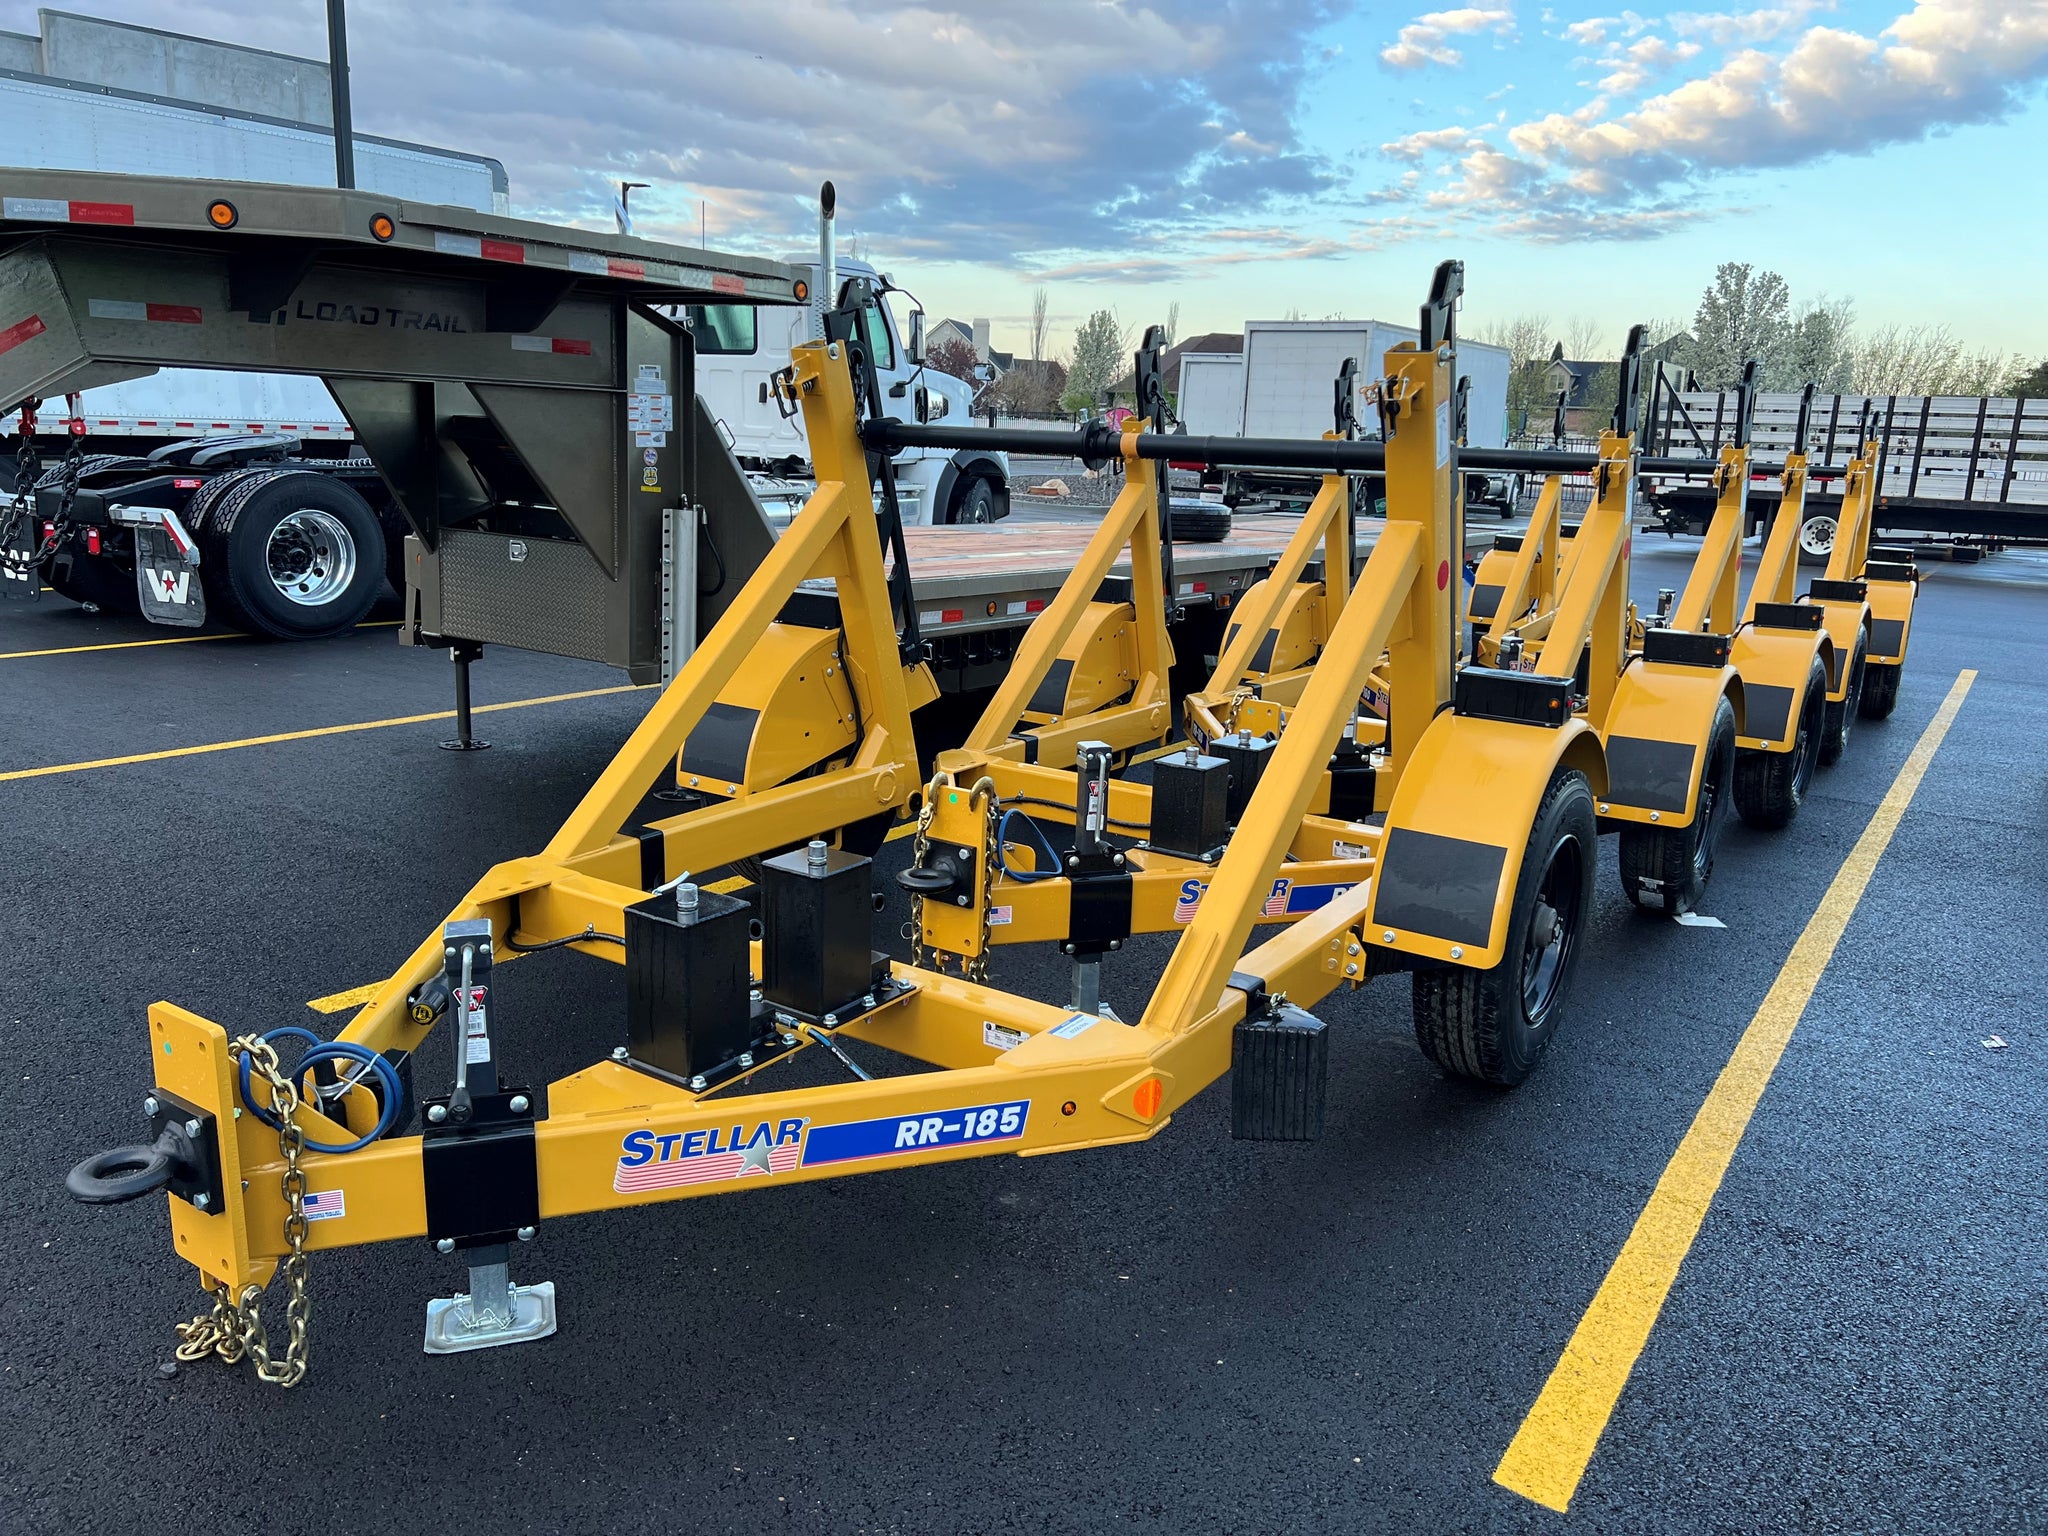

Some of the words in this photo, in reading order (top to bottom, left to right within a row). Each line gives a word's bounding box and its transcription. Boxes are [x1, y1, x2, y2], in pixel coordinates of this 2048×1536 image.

[296, 301, 380, 326] LOAD
[385, 307, 468, 334] TRAIL
[145, 568, 190, 604] W
[620, 1117, 804, 1168] STELLAR
[895, 1106, 1021, 1148] RR-185
